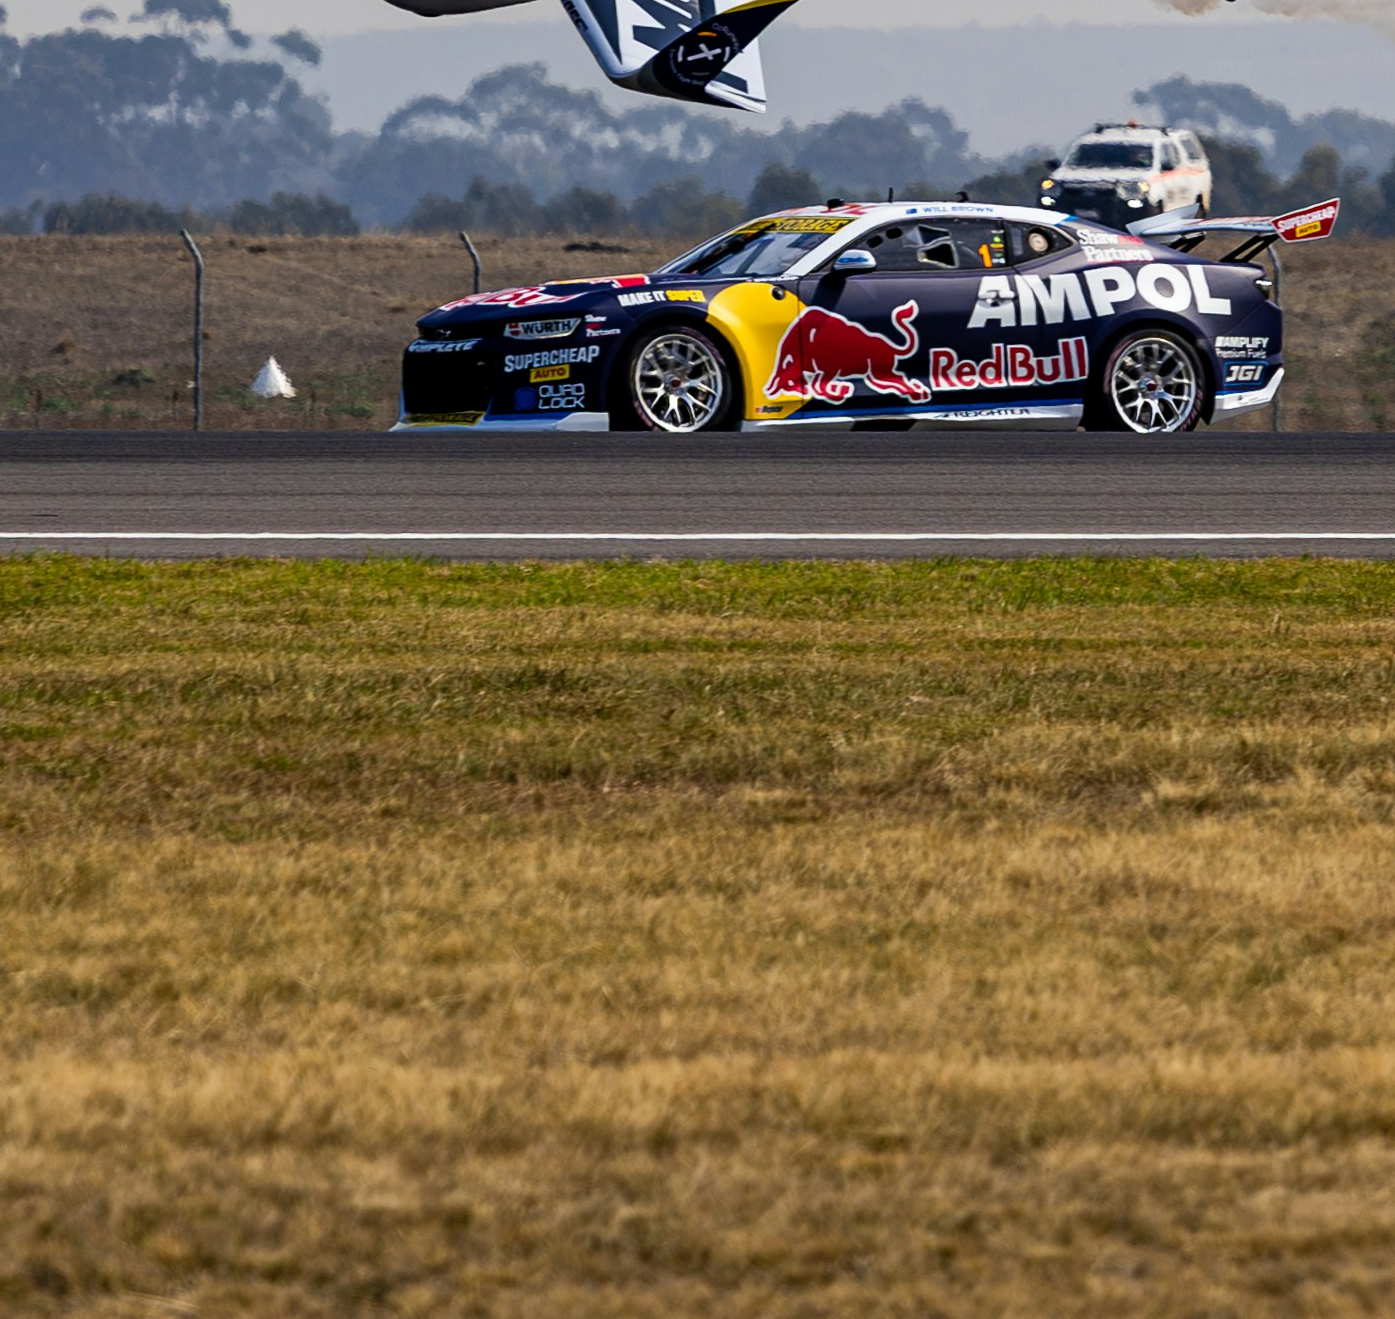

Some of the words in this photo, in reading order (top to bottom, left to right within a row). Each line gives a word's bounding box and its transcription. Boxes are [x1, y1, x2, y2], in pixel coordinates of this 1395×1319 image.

[1076, 229, 1119, 246] Shaw
[978, 243, 993, 268] 1
[1079, 246, 1155, 263] Partners
[617, 290, 654, 307] MAKE
[654, 290, 666, 302] IT
[665, 289, 707, 303] SUPER
[966, 263, 1232, 329] AMPOL
[521, 319, 573, 336] WÜRTH
[503, 345, 601, 374] SUPERCHEAP
[533, 367, 567, 380] AUTO
[1225, 365, 1264, 382] JGI
[538, 383, 586, 398] QUAD
[538, 396, 586, 410] LOCK
